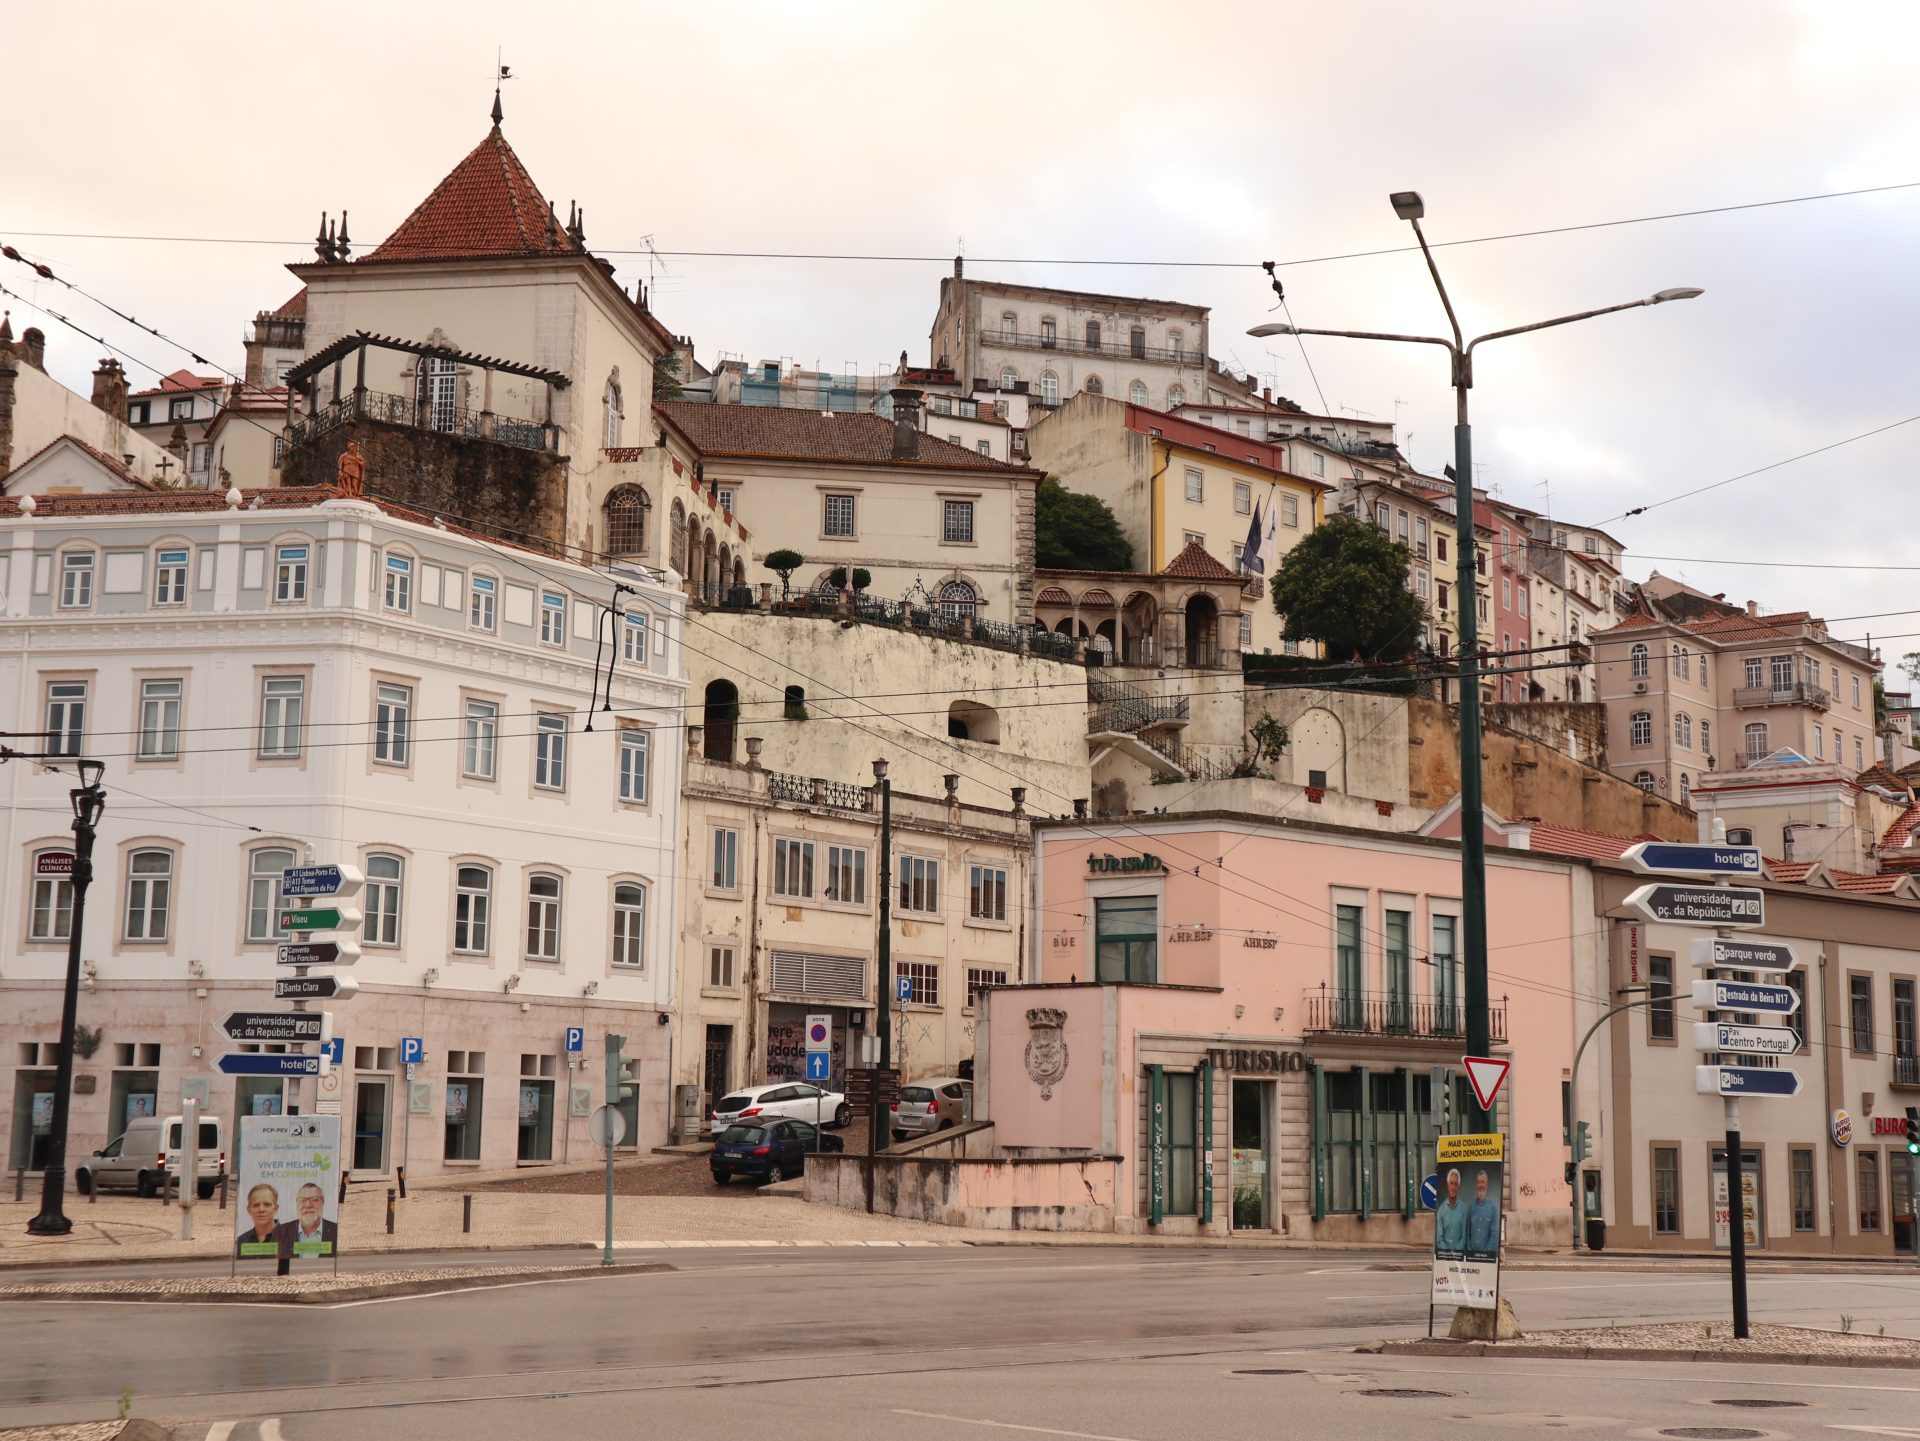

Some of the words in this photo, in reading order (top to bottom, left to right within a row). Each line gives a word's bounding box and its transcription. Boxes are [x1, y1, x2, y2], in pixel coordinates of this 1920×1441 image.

[40, 857, 72, 865] ANÁLISES
[1087, 856, 1162, 872] TURISMO
[1714, 853, 1743, 865] hotel
[300, 885, 319, 894] Figueira
[1674, 892, 1731, 905] universidade
[1658, 906, 1671, 917] pç.
[1674, 906, 1685, 916] da
[1687, 906, 1732, 919] República
[292, 915, 308, 924] Viseu
[1053, 937, 1076, 947] BUE
[1169, 931, 1214, 943] AHRESP
[1243, 938, 1278, 949] AHRESP
[288, 946, 310, 954] Convento
[1725, 949, 1753, 961] parque
[1754, 950, 1777, 961] verde
[297, 954, 320, 962] Francisco
[283, 983, 301, 992] Santa
[302, 982, 319, 992] Clara
[900, 979, 910, 997] P
[1727, 990, 1749, 1001] estrada
[1750, 992, 1758, 1001] da
[1759, 992, 1774, 1003] Beira
[1775, 993, 1788, 1004] N17
[246, 1016, 296, 1026] universidade
[231, 1028, 243, 1039] pç.
[245, 1027, 255, 1037] da
[256, 1027, 295, 1038] República
[569, 1029, 580, 1049] P
[1721, 1031, 1726, 1044] P
[405, 1039, 418, 1061] P
[1729, 1038, 1755, 1048] centro
[1756, 1037, 1789, 1051] Portugal
[280, 1059, 306, 1069] hotel
[1206, 1049, 1306, 1072] TURISMO
[1731, 1073, 1744, 1085] Ibis
[1836, 1122, 1851, 1138] KING
[1448, 1140, 1461, 1148] MAIS
[1462, 1138, 1492, 1147] CIDADANIA
[1440, 1150, 1462, 1158] MELHOR
[1463, 1149, 1500, 1157] DEMOCRACIA
[258, 1161, 284, 1169] VIVER
